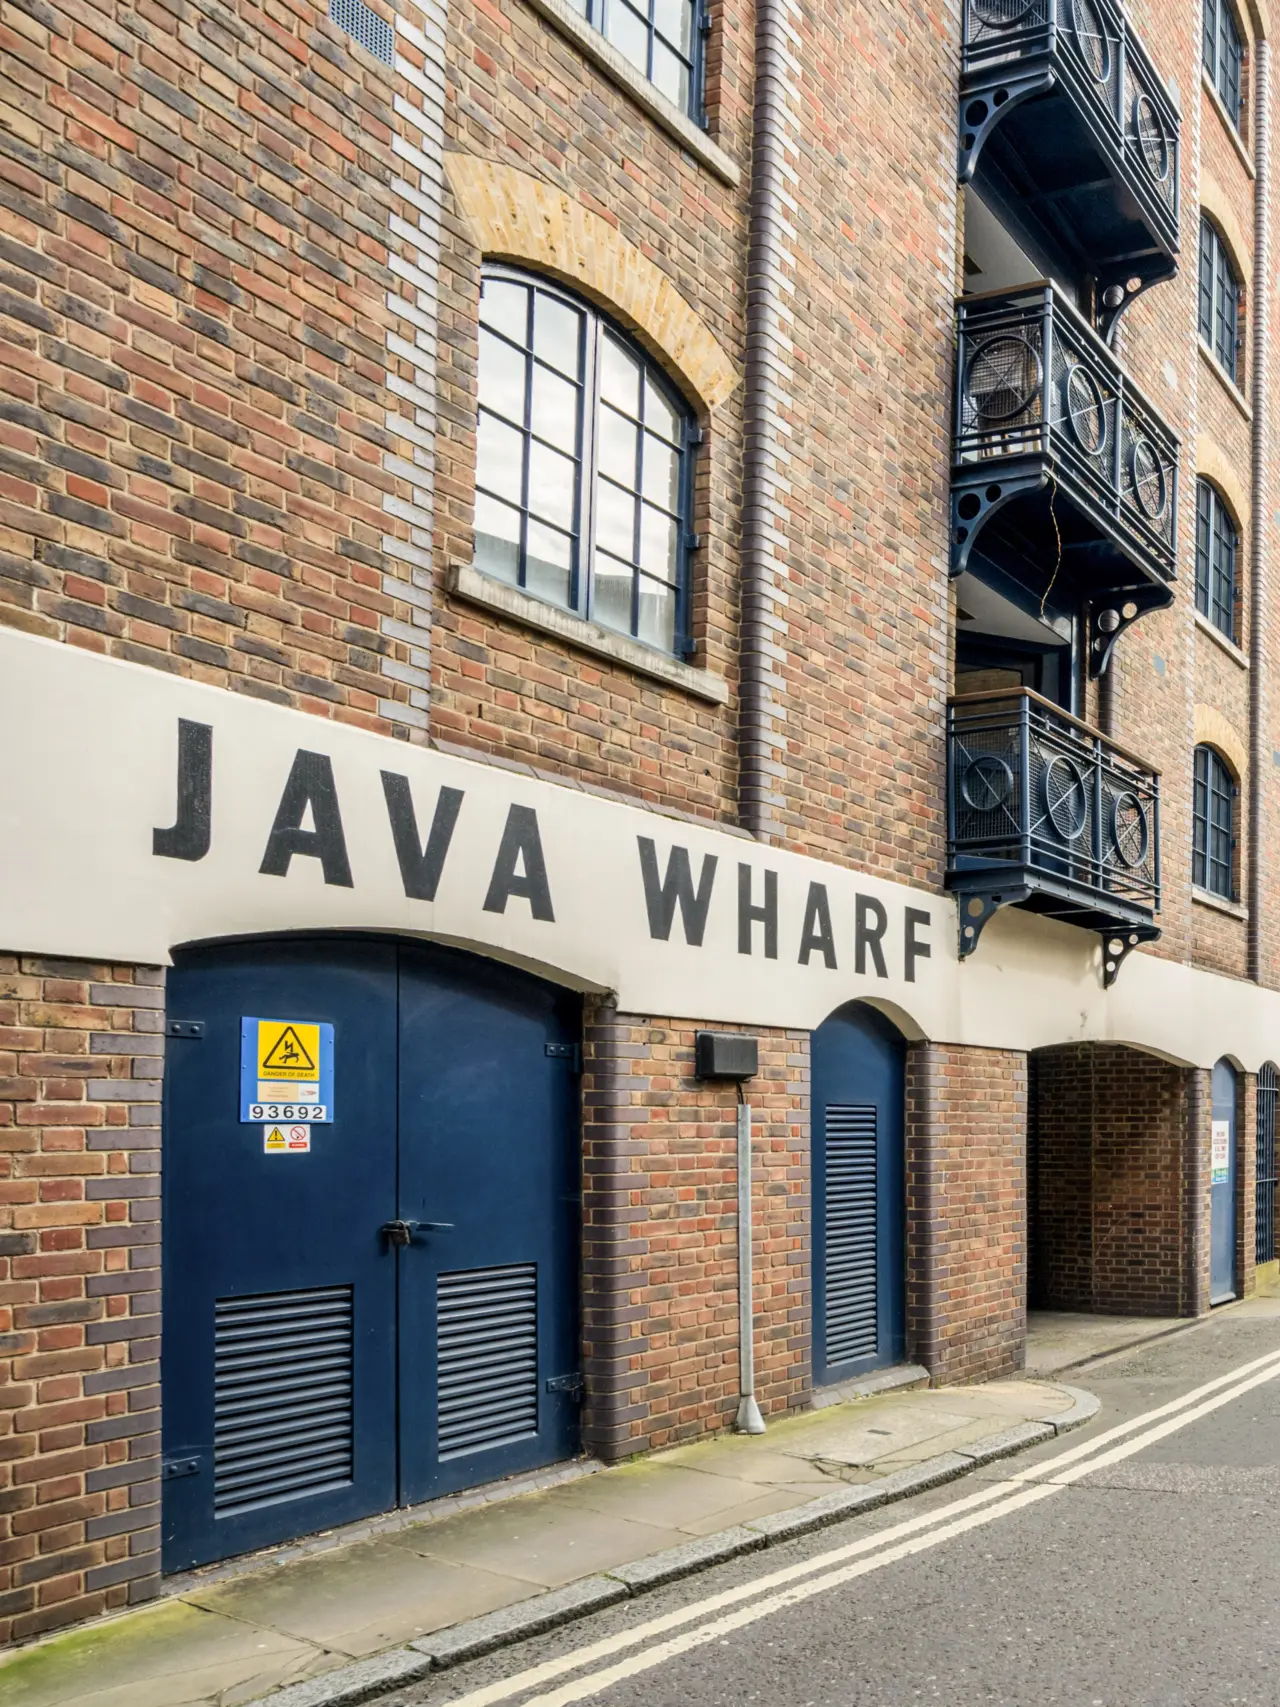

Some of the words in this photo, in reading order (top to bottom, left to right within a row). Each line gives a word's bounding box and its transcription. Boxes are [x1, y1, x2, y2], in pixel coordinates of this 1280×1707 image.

[152, 717, 556, 923] JAVA
[637, 835, 934, 984] WHARF
[252, 1105, 323, 1120] 93692
